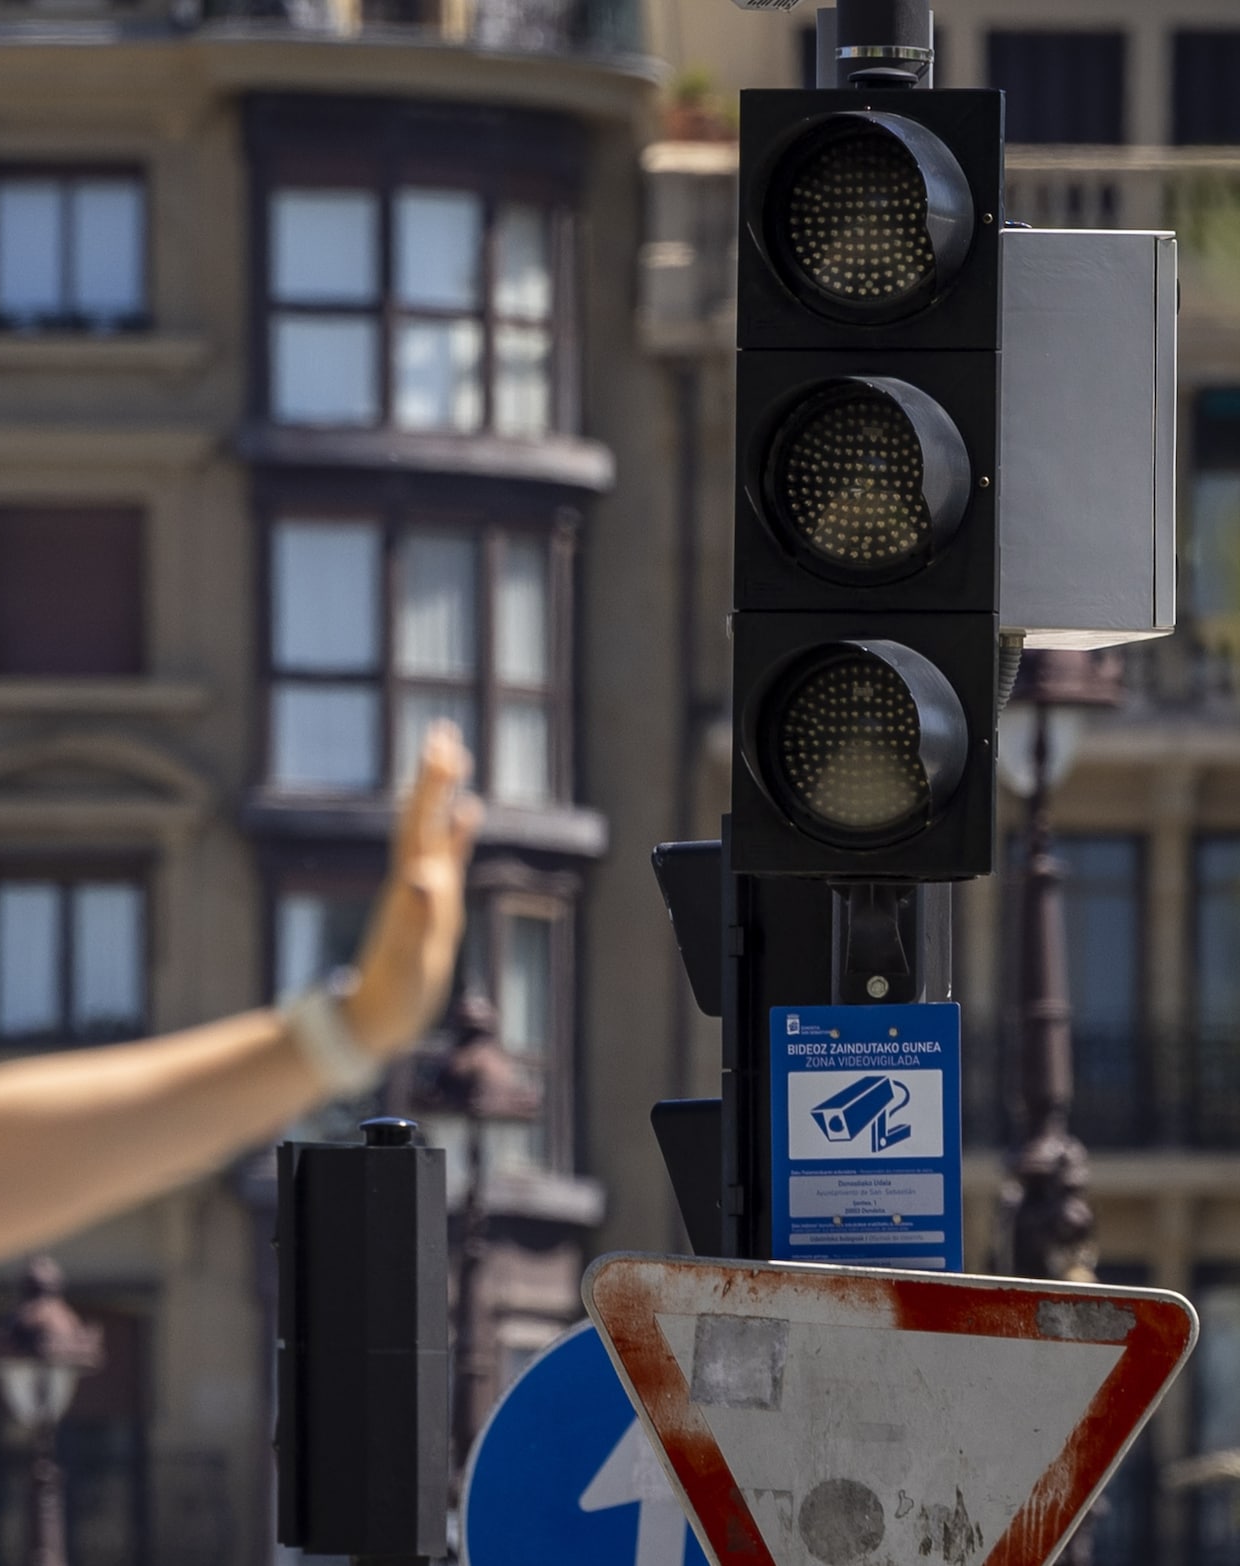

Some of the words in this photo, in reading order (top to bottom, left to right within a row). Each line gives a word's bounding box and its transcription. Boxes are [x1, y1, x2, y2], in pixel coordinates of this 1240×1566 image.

[787, 1043, 827, 1055] BIDEOZ
[830, 1042, 899, 1054] ZAINDUTAKO
[902, 1041, 942, 1053] GUNEA
[805, 1056, 835, 1068] ZONA
[838, 1054, 920, 1067] VIDEOVIGILADA
